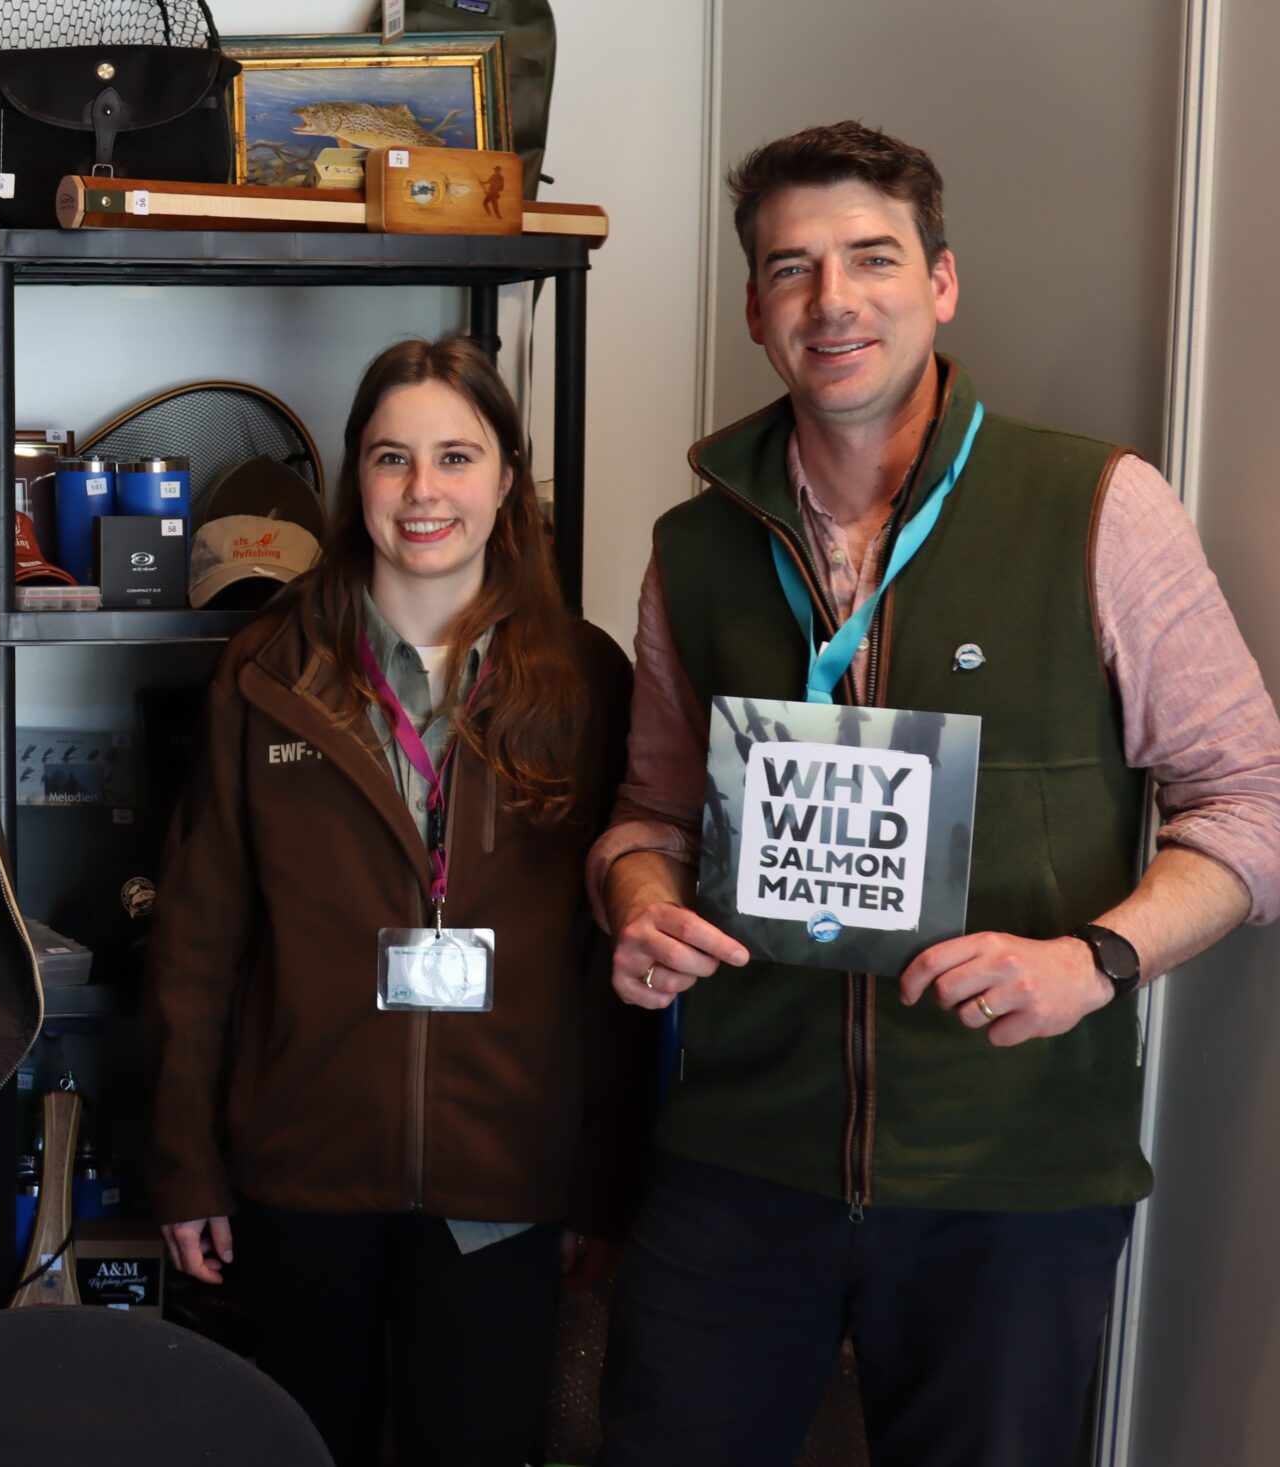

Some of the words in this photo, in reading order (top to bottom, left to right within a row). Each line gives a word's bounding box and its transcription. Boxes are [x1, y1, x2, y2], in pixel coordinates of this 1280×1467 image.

[394, 156, 404, 165] 72
[139, 197, 147, 208] 56
[52, 433, 61, 441] 60
[90, 483, 104, 492] 141
[164, 486, 177, 495] 143
[167, 525, 177, 533] 58
[233, 550, 281, 560] flyfishing
[762, 757, 912, 807] WHY
[49, 791, 98, 803] Melodien
[761, 801, 909, 850] WILD
[759, 845, 907, 881] SALMON
[757, 876, 905, 913] MATTER
[96, 1261, 139, 1276] A&M
